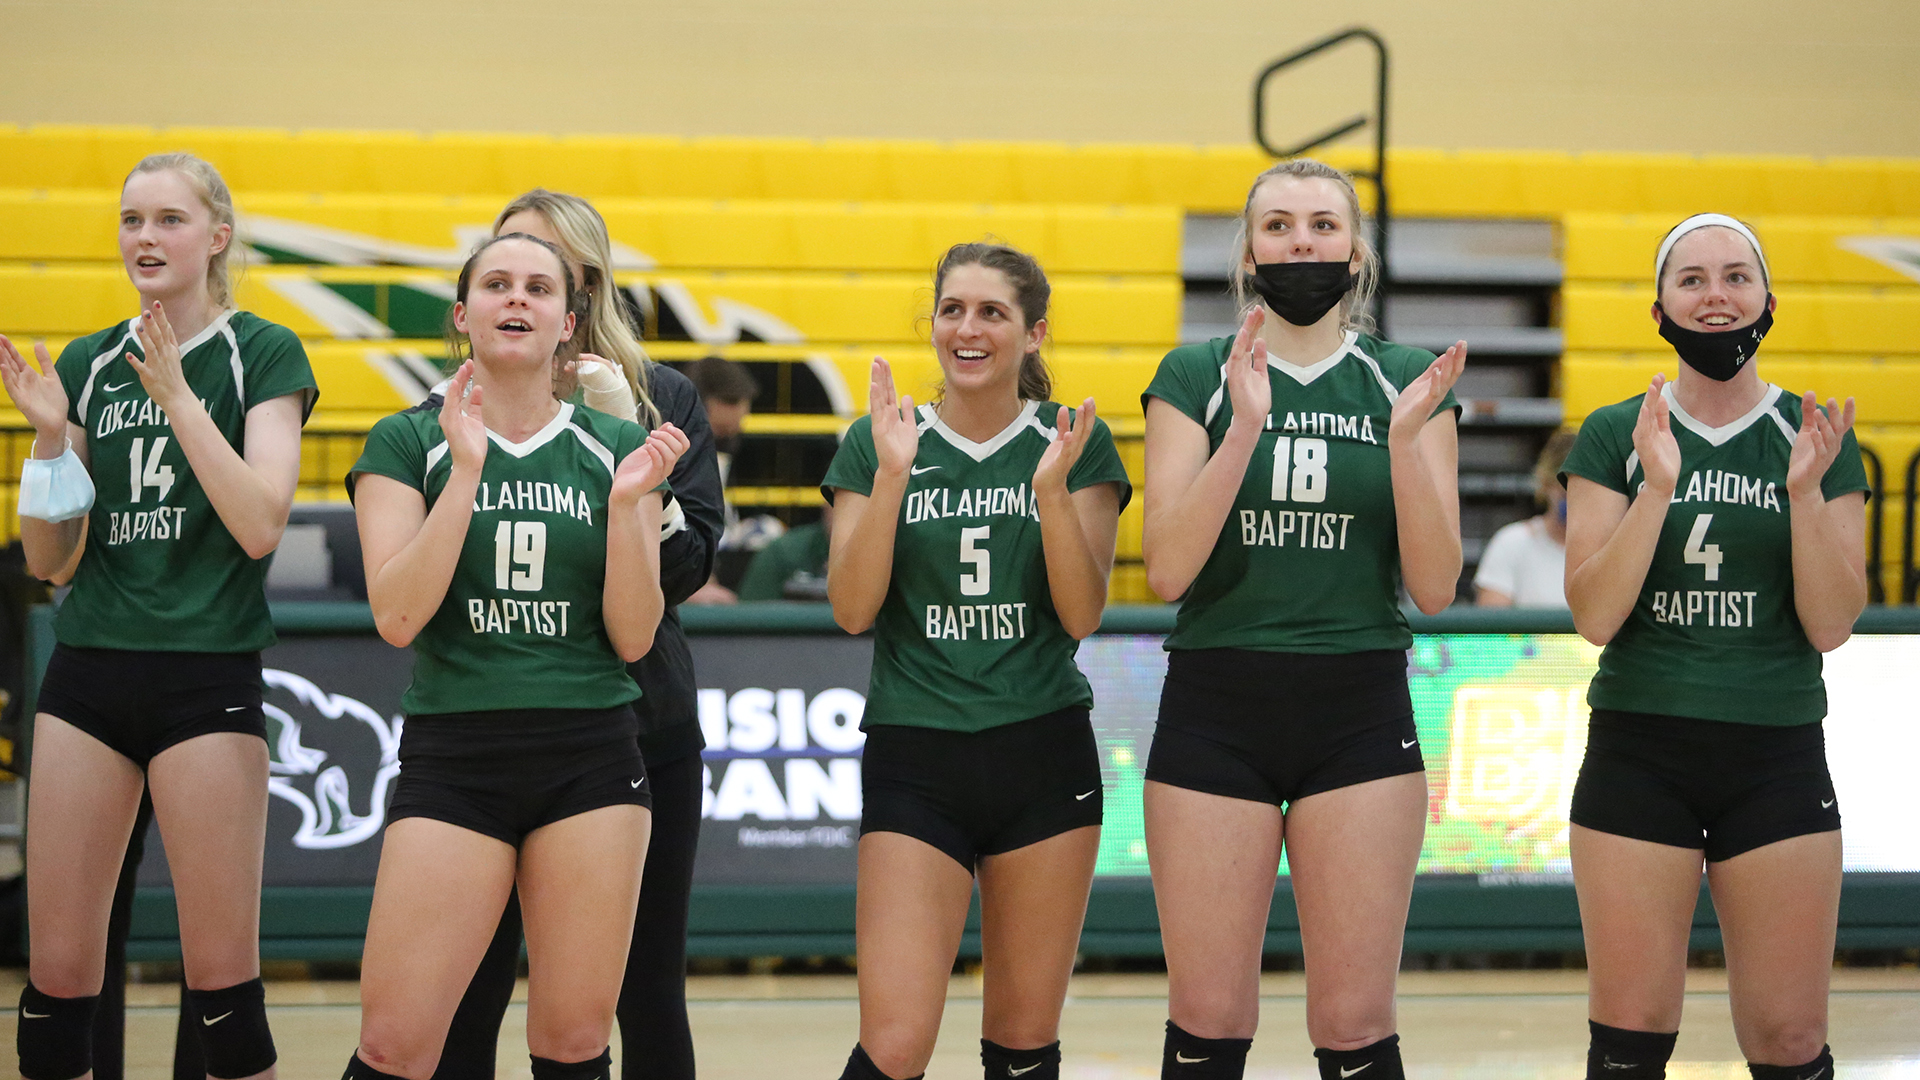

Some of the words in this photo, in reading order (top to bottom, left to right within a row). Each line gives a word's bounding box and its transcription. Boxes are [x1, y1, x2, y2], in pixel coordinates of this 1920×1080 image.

[96, 396, 215, 439] OKLAH
[1230, 411, 1378, 445] LAHOMA
[129, 436, 175, 503] 14
[1271, 436, 1328, 504] 18
[107, 506, 187, 546] BAPTIST
[472, 480, 593, 527] LAHOMA
[1239, 509, 1355, 550] BAPTIST
[1683, 513, 1723, 581] 4
[494, 520, 547, 592] 19
[959, 525, 991, 596] 5
[468, 598, 571, 637] BAPTIST
[926, 602, 1027, 641] BAPTIST
[1652, 590, 1757, 628] BAPTIST
[697, 686, 868, 754] ISIO
